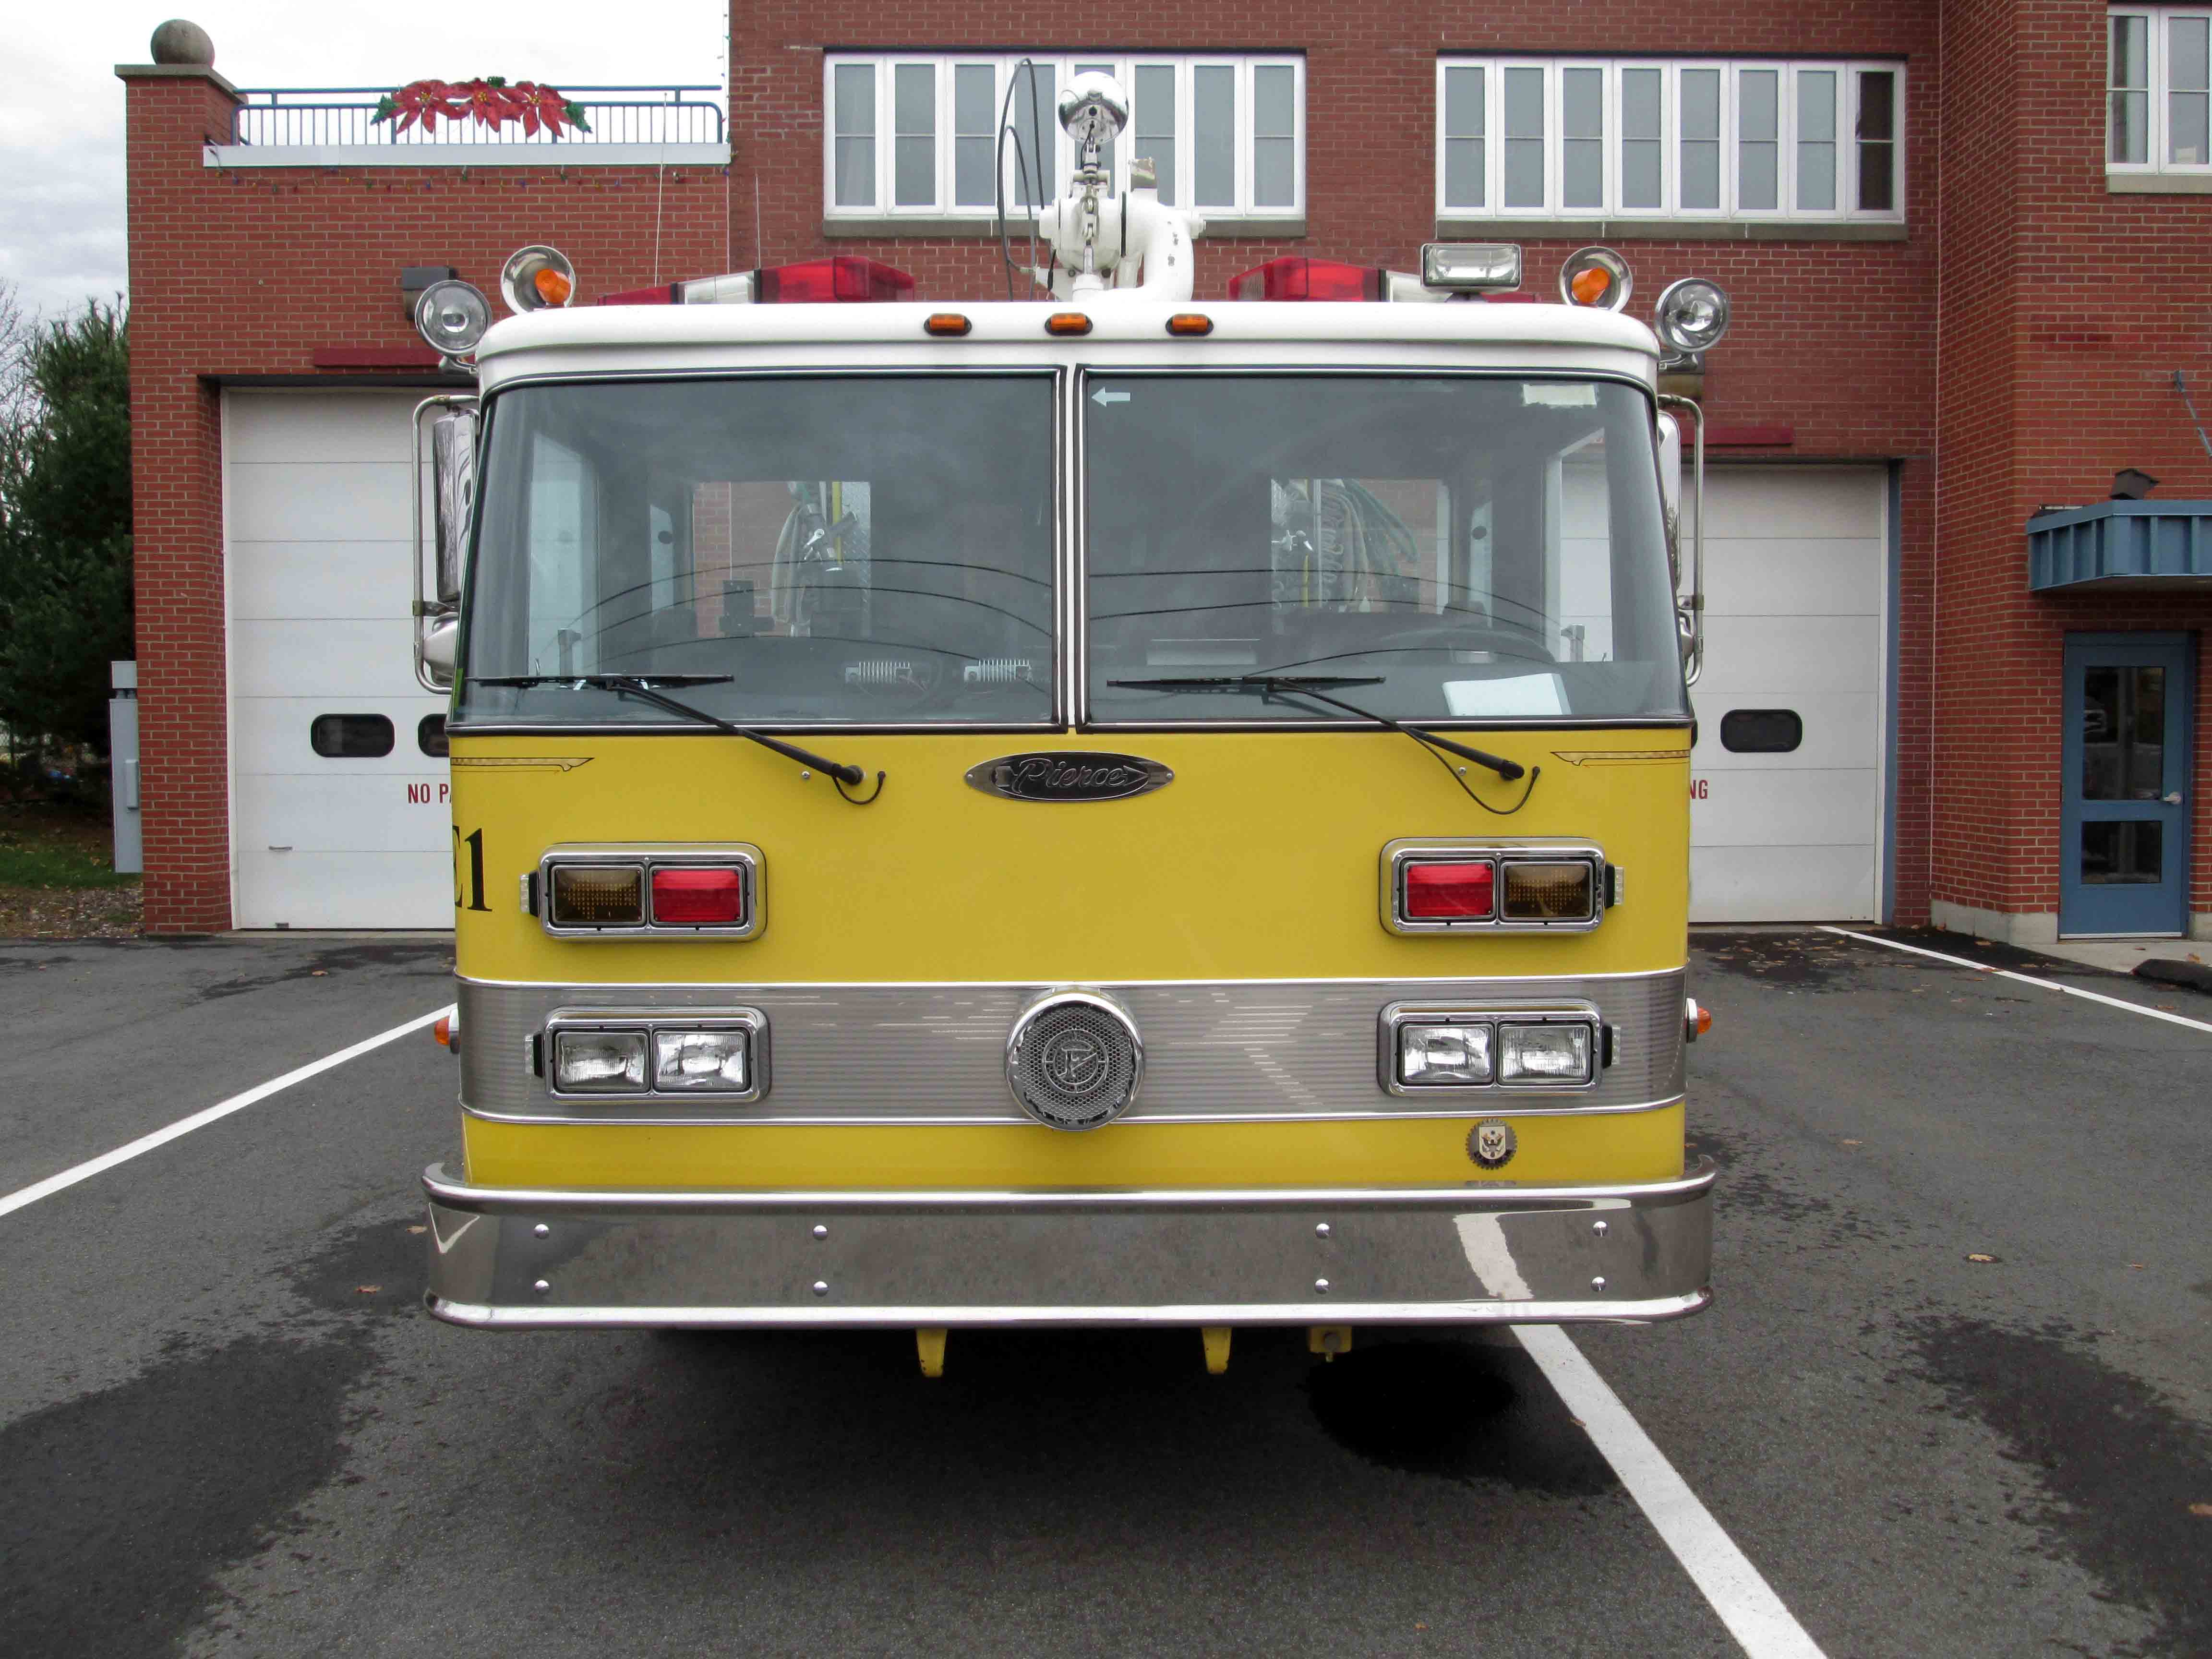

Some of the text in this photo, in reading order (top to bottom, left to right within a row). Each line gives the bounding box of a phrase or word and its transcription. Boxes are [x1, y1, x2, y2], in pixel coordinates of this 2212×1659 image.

[1011, 758, 1126, 794] Pierce
[408, 783, 451, 804] NO P
